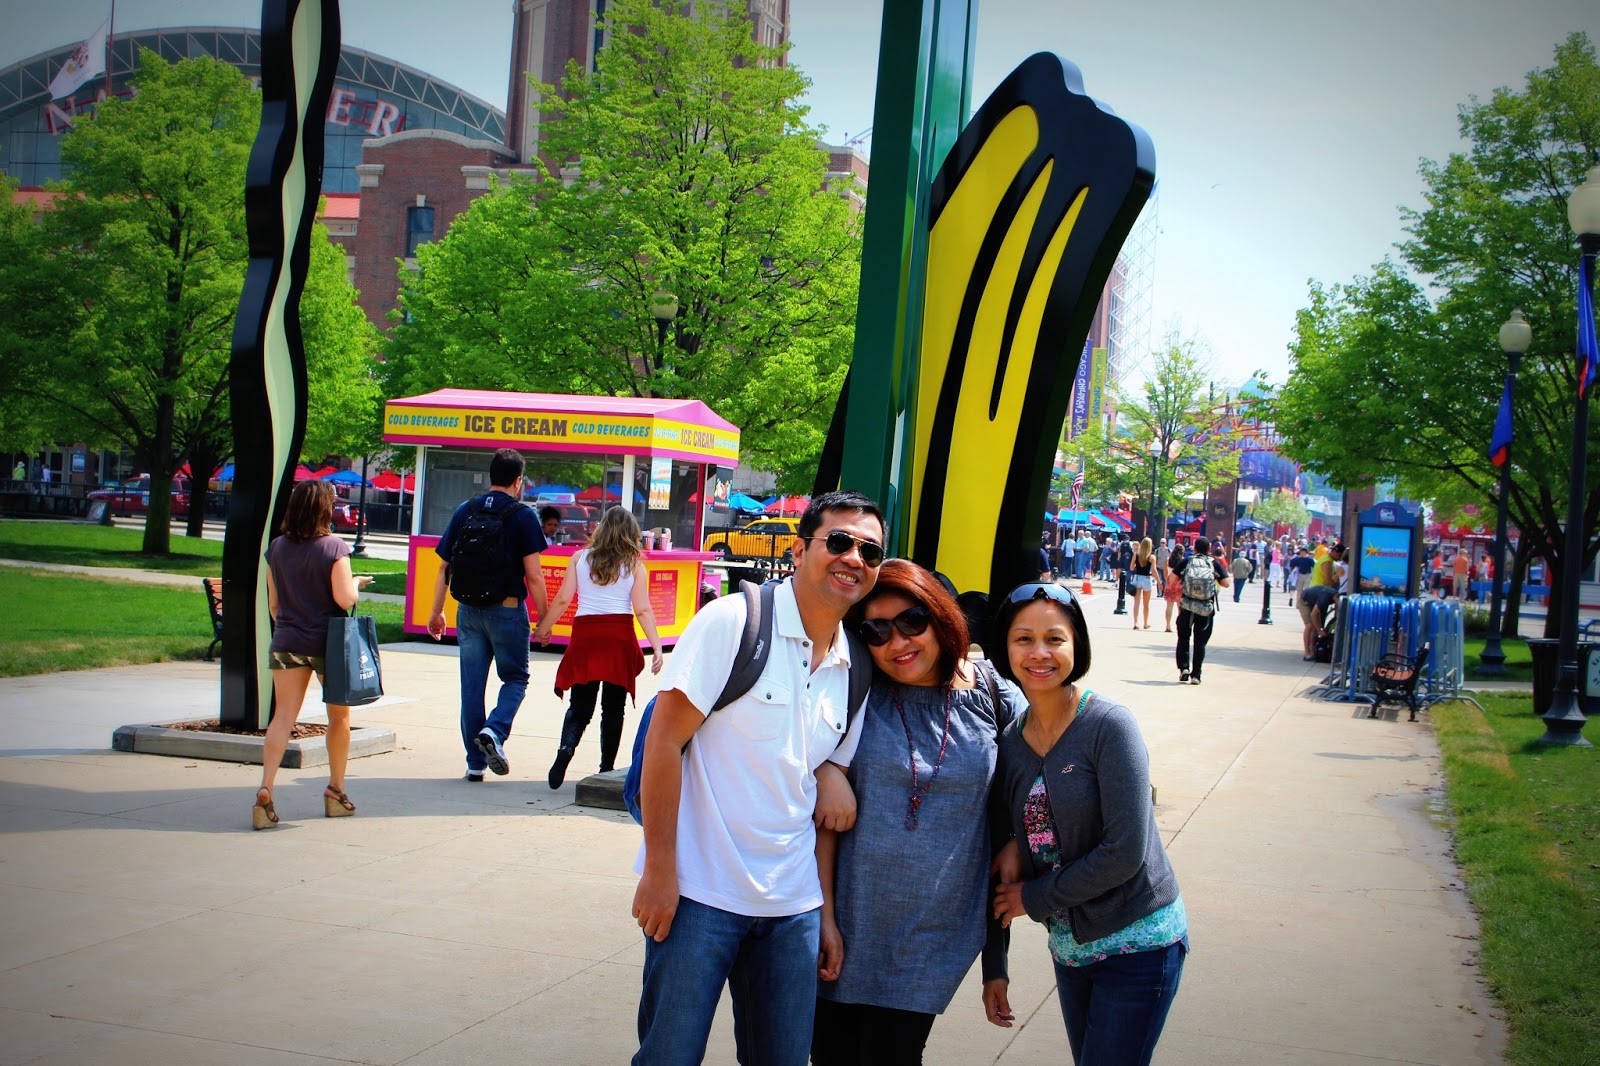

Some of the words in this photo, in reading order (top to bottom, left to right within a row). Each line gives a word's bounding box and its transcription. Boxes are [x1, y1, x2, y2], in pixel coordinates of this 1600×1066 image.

[388, 414, 408, 425] COLD
[411, 415, 459, 428] BEVERAGES
[464, 415, 496, 433] ICE
[501, 417, 568, 437] CREAM
[572, 423, 595, 434] COLD
[597, 424, 651, 437] BEVERAGES
[681, 428, 692, 446] ICE
[693, 430, 715, 449] CREAM
